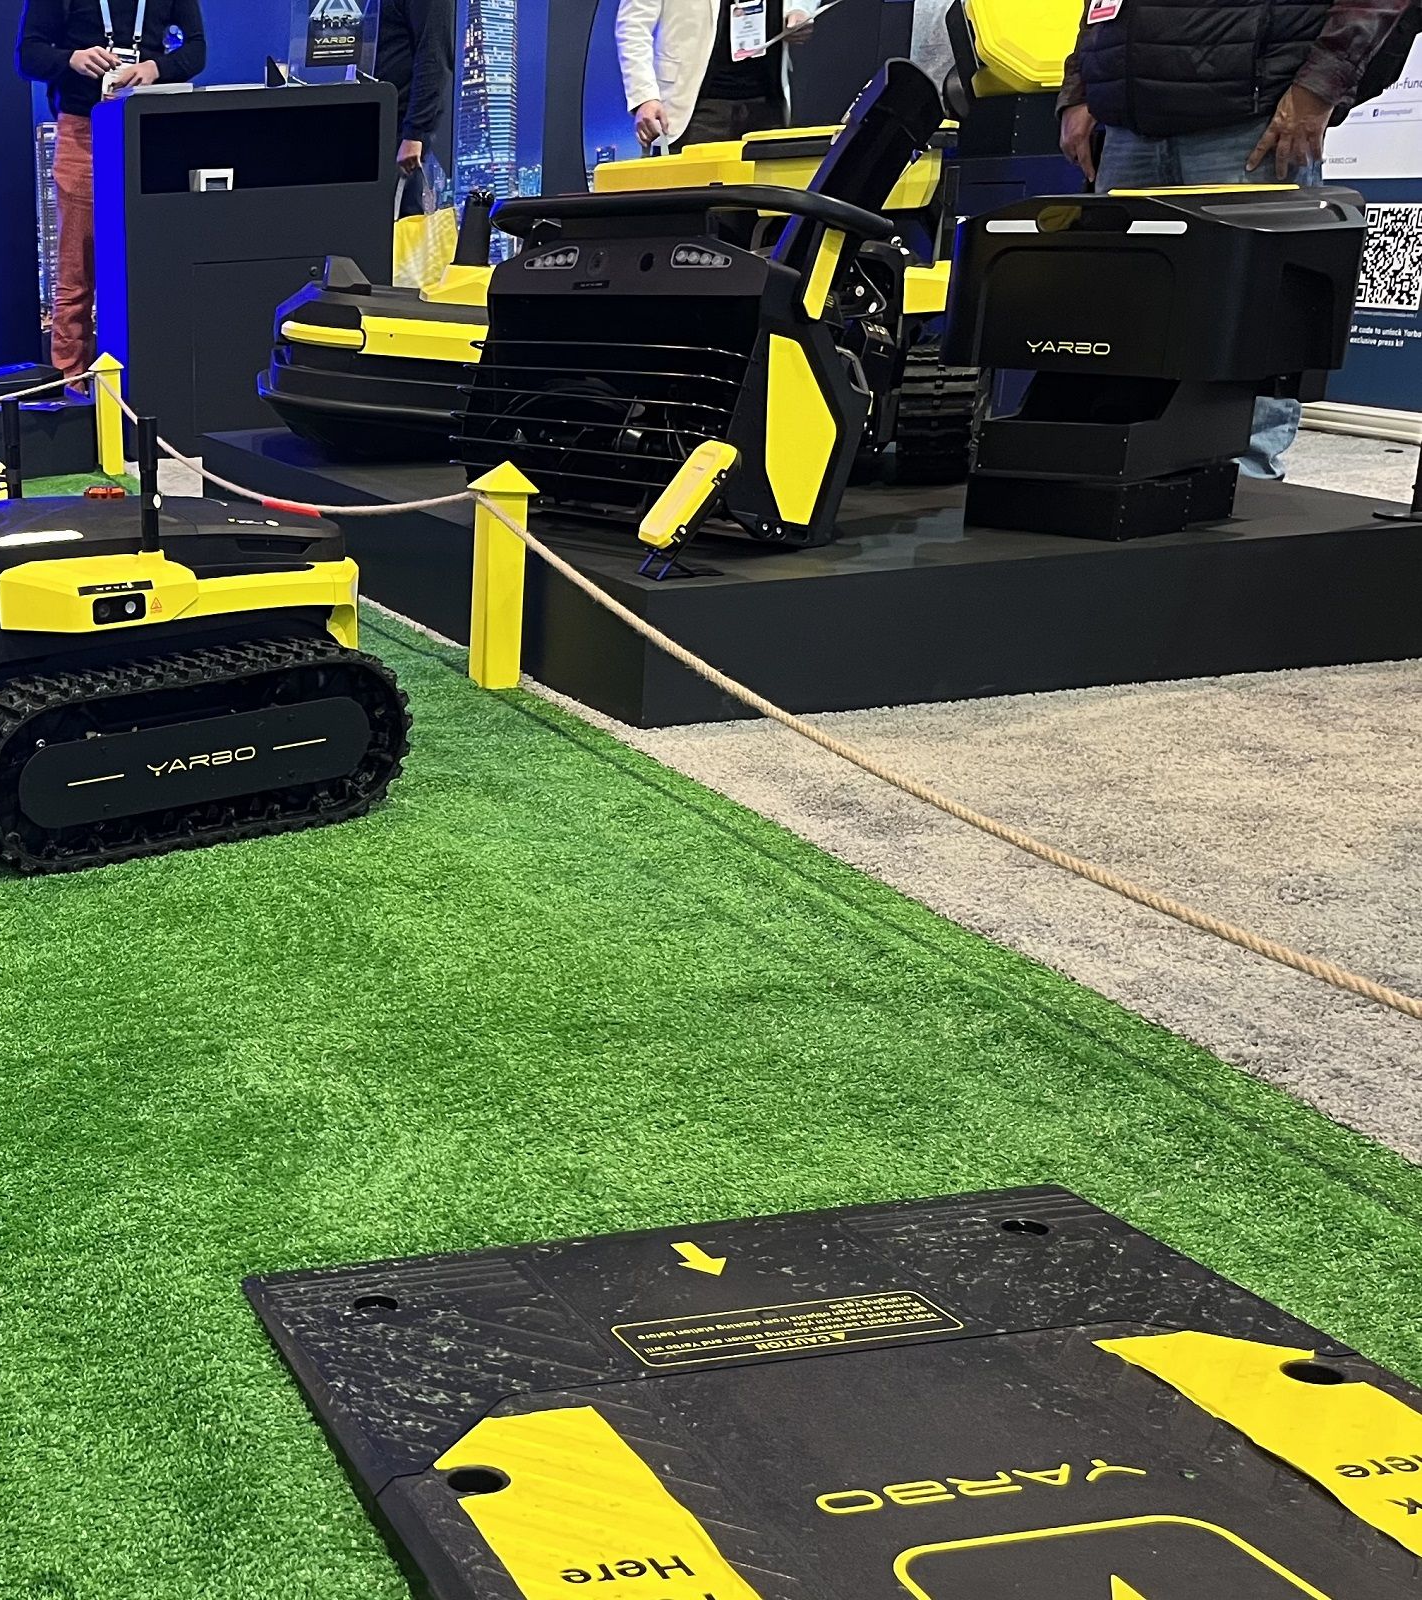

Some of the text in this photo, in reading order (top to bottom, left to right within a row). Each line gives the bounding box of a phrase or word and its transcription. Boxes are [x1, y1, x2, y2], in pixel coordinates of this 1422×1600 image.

[314, 36, 356, 45] YARBO
[1026, 340, 1111, 356] YARBO
[147, 746, 256, 777] YARBO
[667, 1342, 701, 1350] Yarbo
[755, 1335, 831, 1351] CAUTION
[1335, 1455, 1422, 1479] ere
[815, 1459, 1147, 1514] YARBO
[559, 1555, 696, 1584] Here
